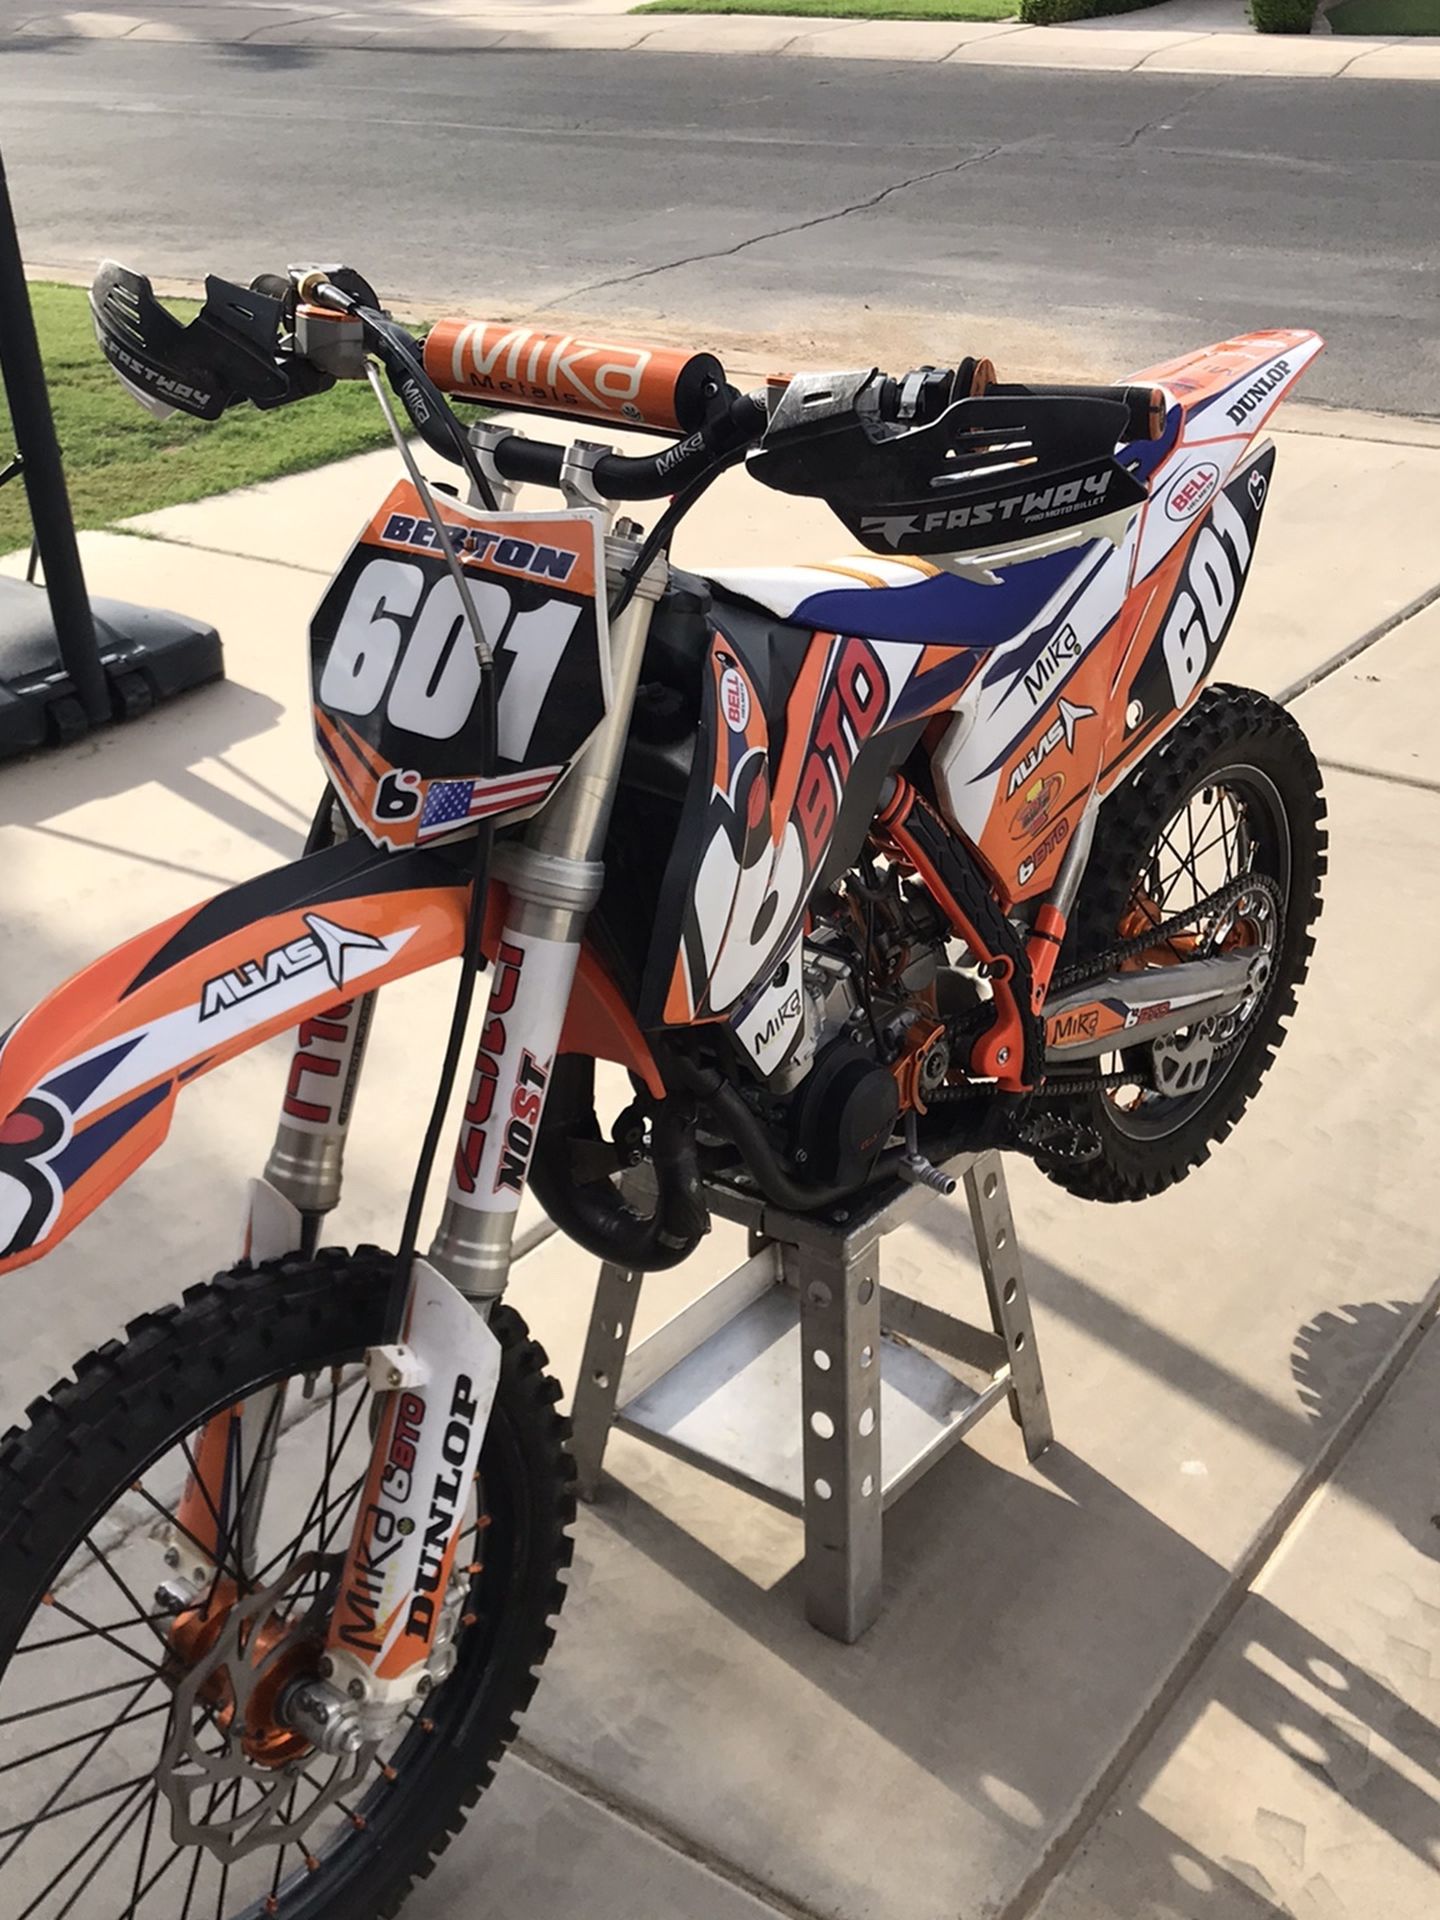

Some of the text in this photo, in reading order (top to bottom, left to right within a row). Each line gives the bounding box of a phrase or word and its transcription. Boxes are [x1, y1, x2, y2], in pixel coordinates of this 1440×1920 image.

[107, 344, 211, 406] FASTWAY
[469, 371, 578, 405] Metals
[1225, 359, 1292, 427] DUNLOP
[924, 470, 1113, 532] FASTWAY
[1045, 505, 1073, 518] MOTO
[1170, 470, 1214, 513] BELL
[380, 512, 580, 583] BERTON
[1163, 488, 1251, 709] 601
[320, 558, 583, 763] 601
[728, 675, 740, 723] BELL
[405, 1373, 477, 1643] DUNLOP
